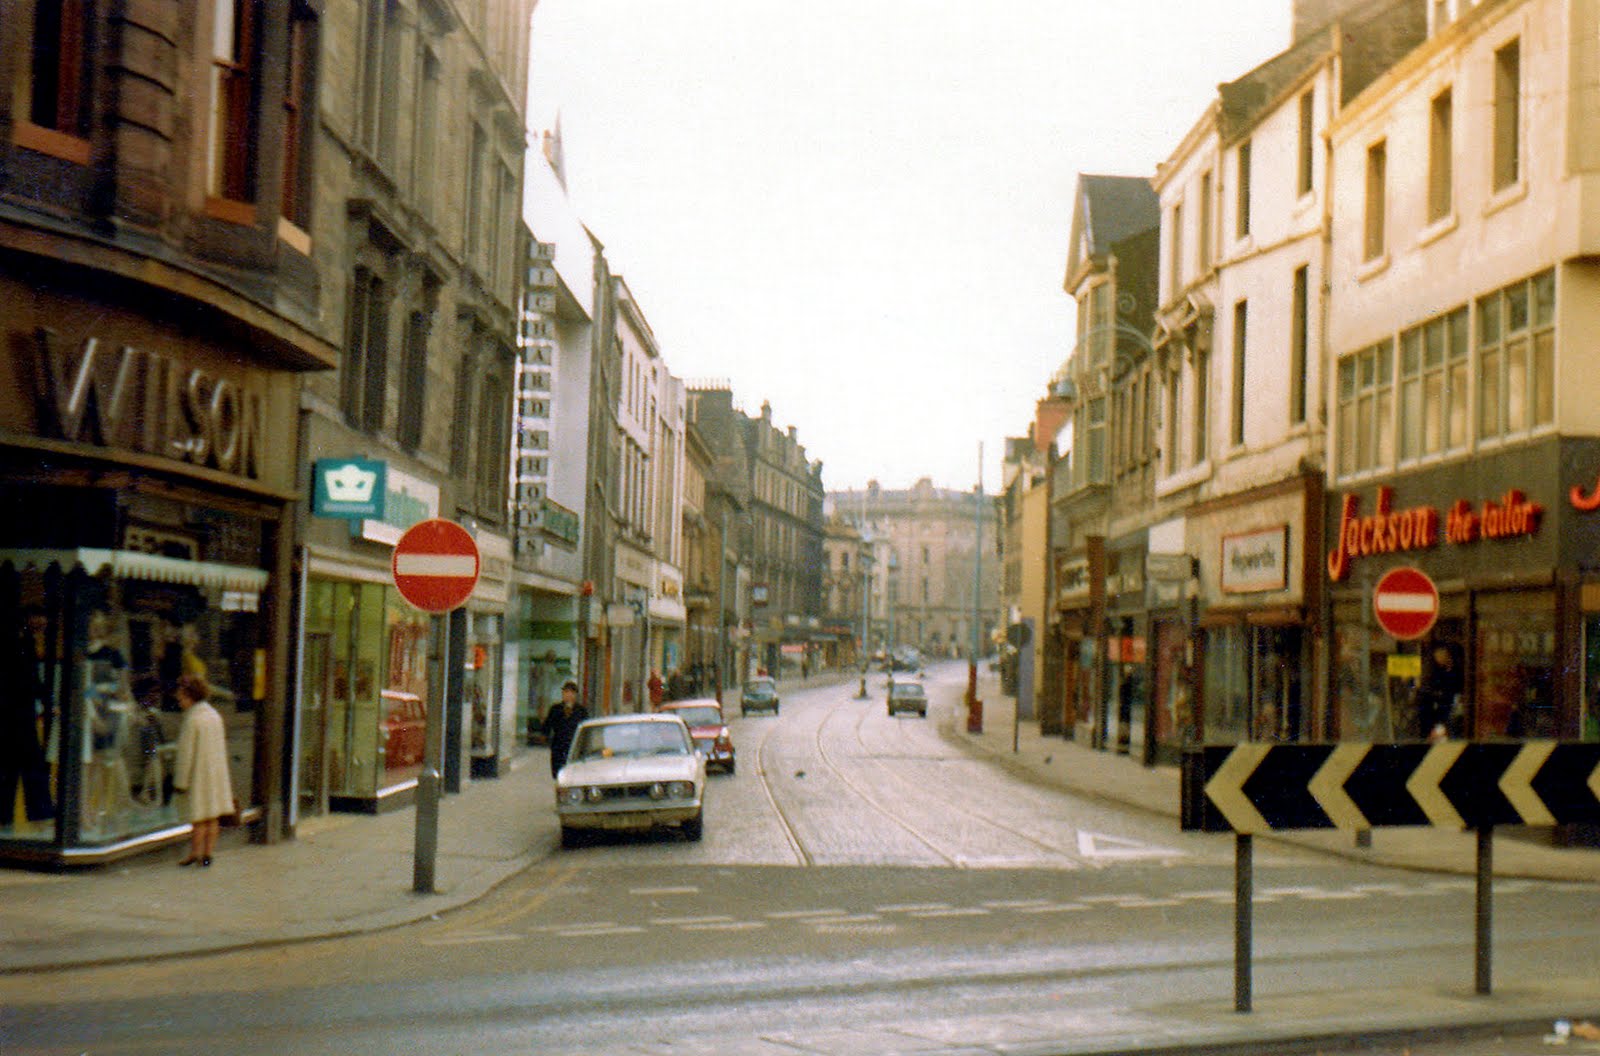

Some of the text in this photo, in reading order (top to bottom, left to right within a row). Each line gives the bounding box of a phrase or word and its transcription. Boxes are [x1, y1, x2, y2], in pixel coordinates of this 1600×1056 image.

[523, 431, 545, 553] SHOPS
[1327, 486, 1438, 582] Jackson
[1445, 499, 1480, 544] the
[1481, 489, 1543, 538] tailor
